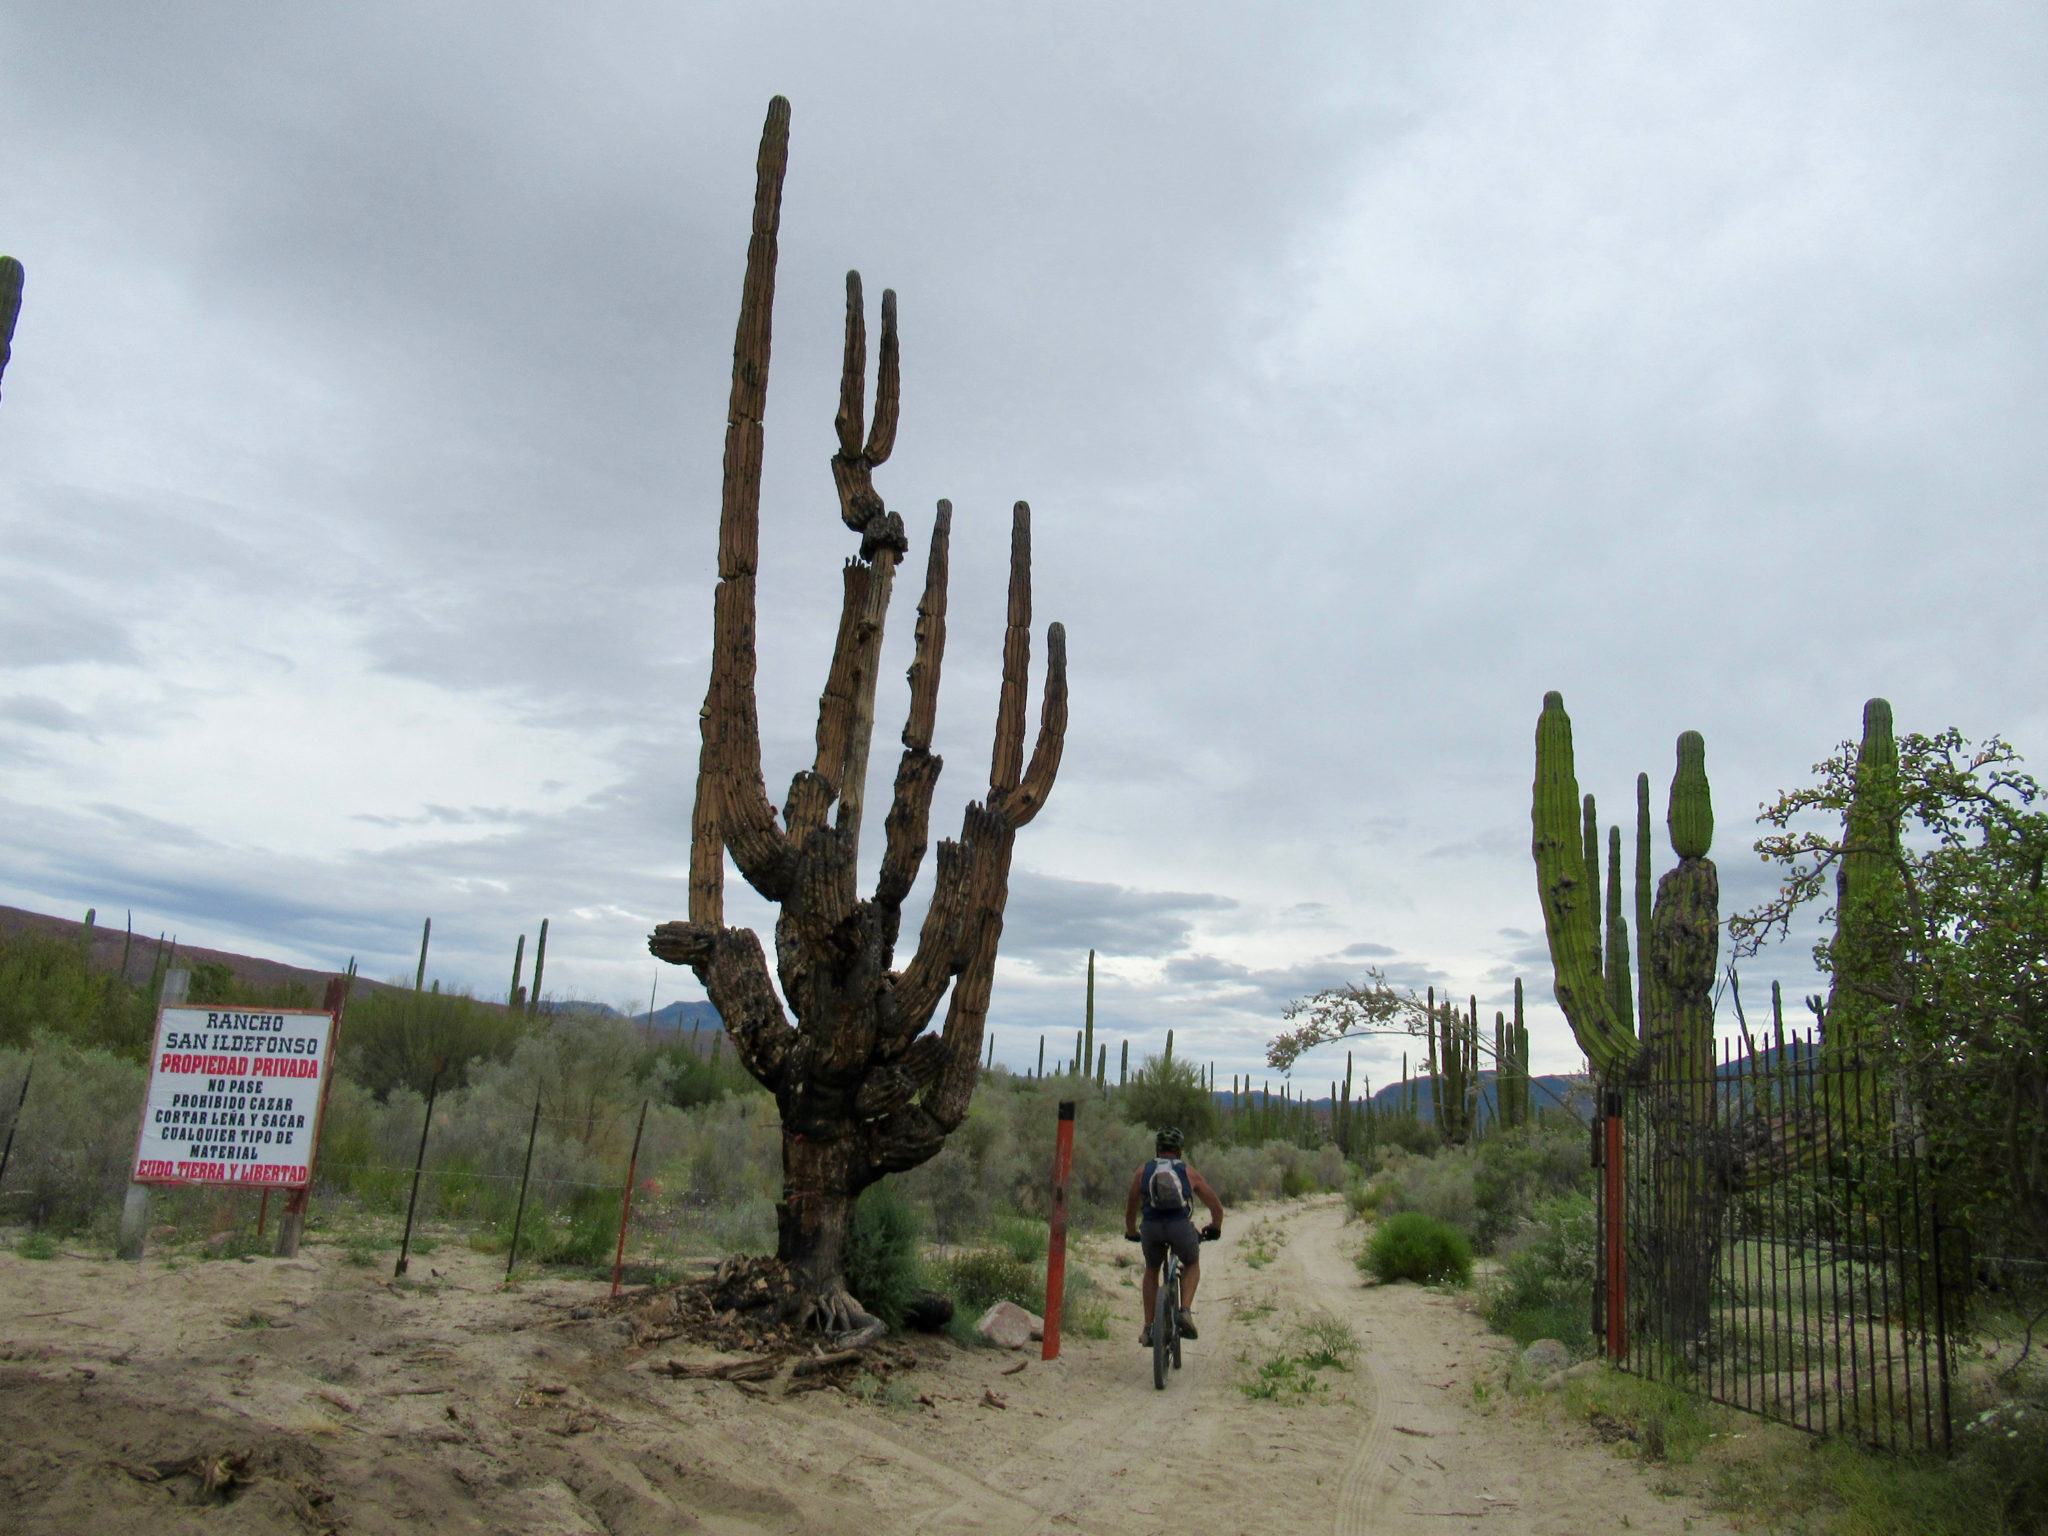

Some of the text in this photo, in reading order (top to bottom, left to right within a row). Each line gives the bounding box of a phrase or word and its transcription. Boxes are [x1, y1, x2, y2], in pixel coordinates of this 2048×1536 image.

[207, 1013, 283, 1032] RANCHO
[166, 1033, 318, 1054] SAN ILDEFONSO
[160, 1054, 318, 1078] PROPIEDAD PRIVADA
[208, 1079, 263, 1093] NO PASE
[172, 1094, 293, 1111] PROHIBIDO CAZAR
[155, 1110, 305, 1128] CORTAR LEÑA Y SACAR
[162, 1127, 293, 1144] CUALQUIER TIPO DE
[190, 1145, 258, 1160] MATERIAL
[138, 1160, 307, 1181] EJIDO TIERRA Y LIBERTAD
